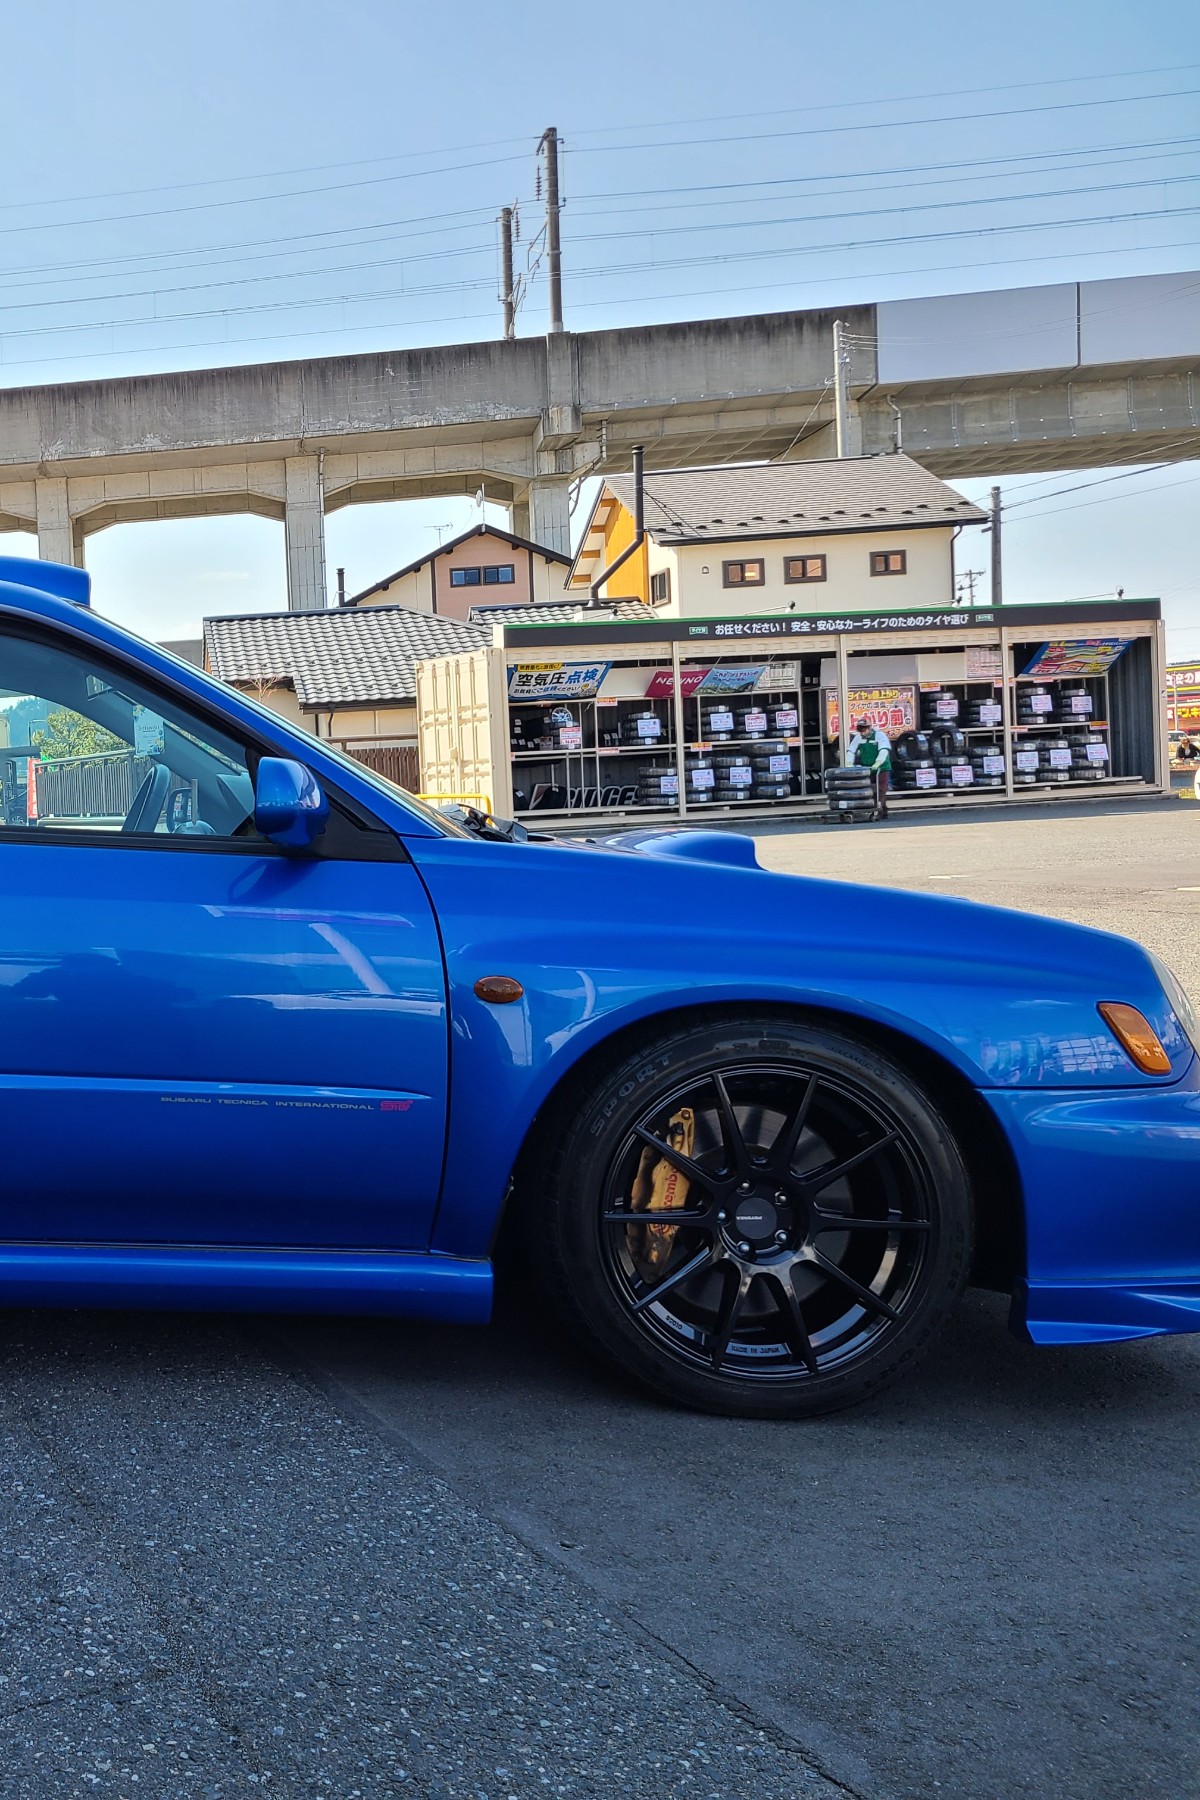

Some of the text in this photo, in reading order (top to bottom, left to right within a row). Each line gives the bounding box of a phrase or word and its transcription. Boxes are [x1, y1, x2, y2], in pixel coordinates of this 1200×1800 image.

[515, 668, 599, 687] 空気圧点検
[160, 1096, 212, 1104] SUBARU
[217, 1098, 269, 1106] TECNICA
[275, 1100, 375, 1110] INTERNATIONAL
[590, 1051, 673, 1137] SPORT
